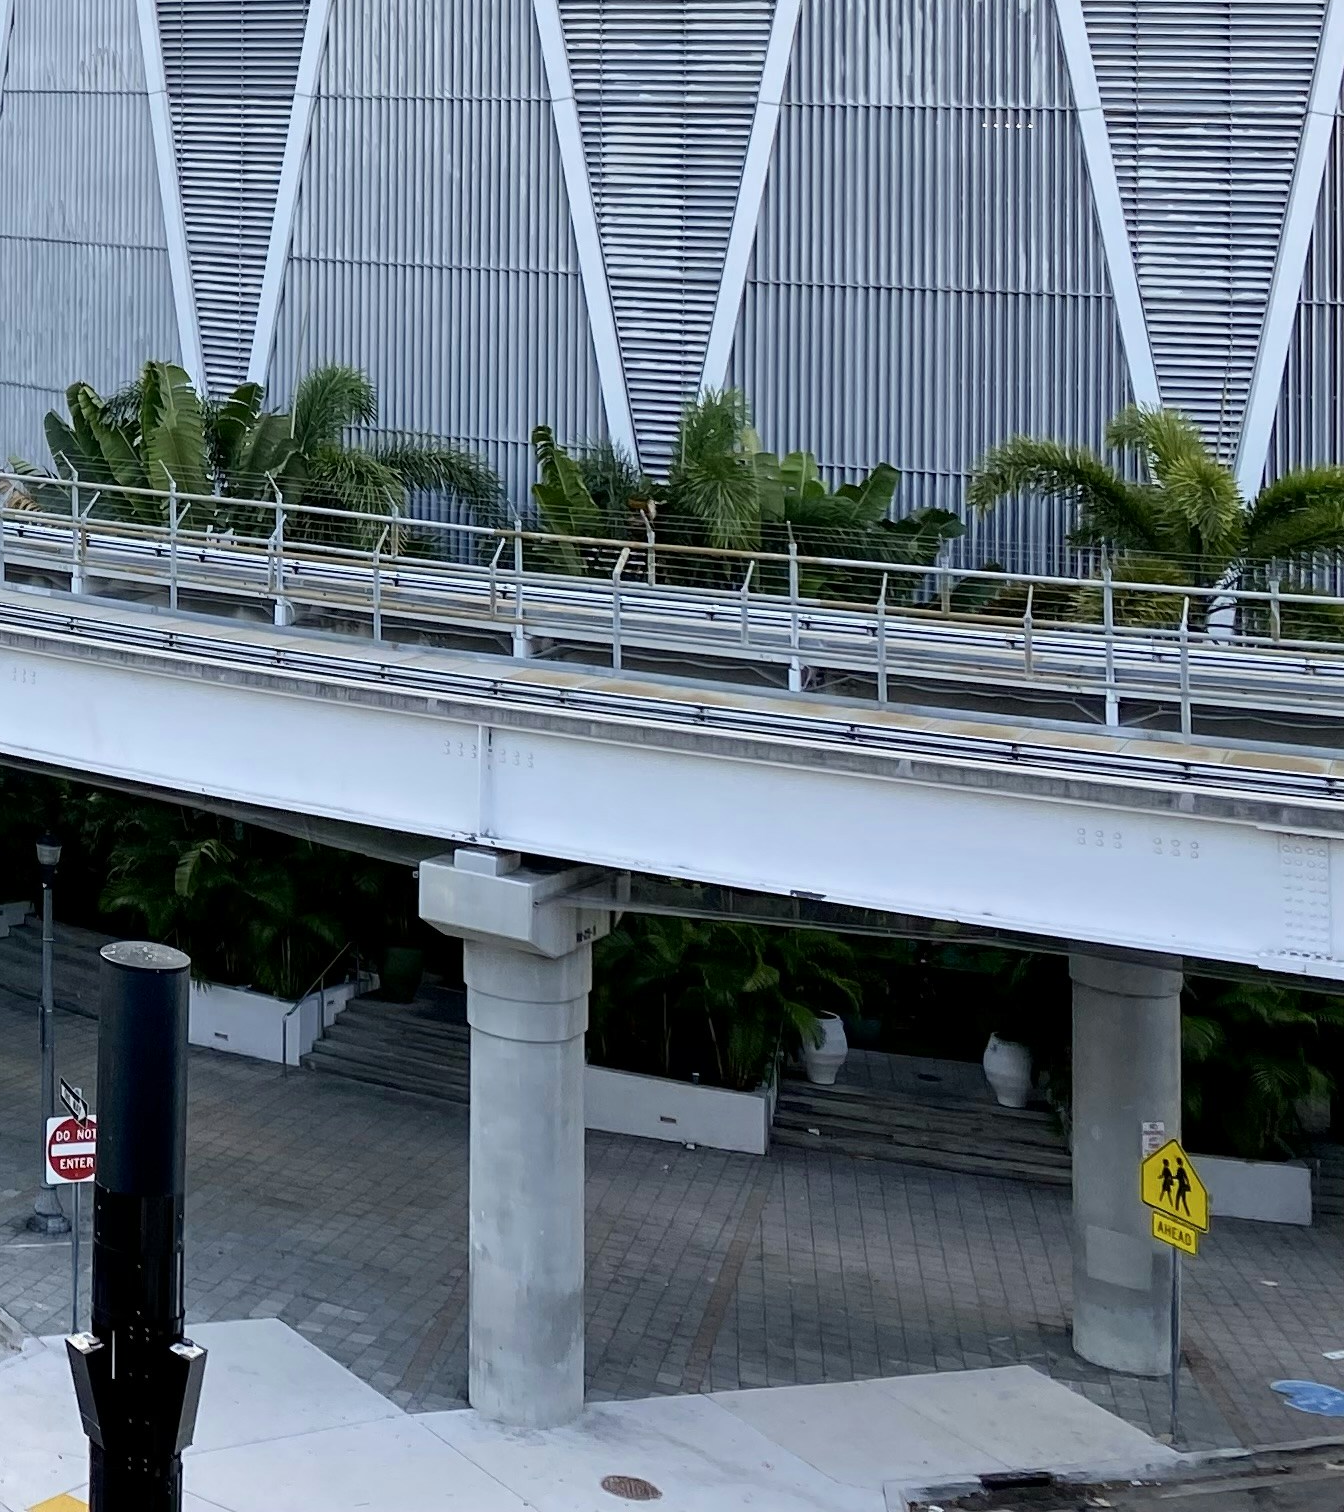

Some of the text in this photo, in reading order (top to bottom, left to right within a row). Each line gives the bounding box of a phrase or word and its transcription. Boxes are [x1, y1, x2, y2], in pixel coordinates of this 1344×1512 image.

[55, 1128, 97, 1142] DO NOT
[59, 1157, 94, 1170] ENTER
[1157, 1220, 1192, 1246] AHEAD
